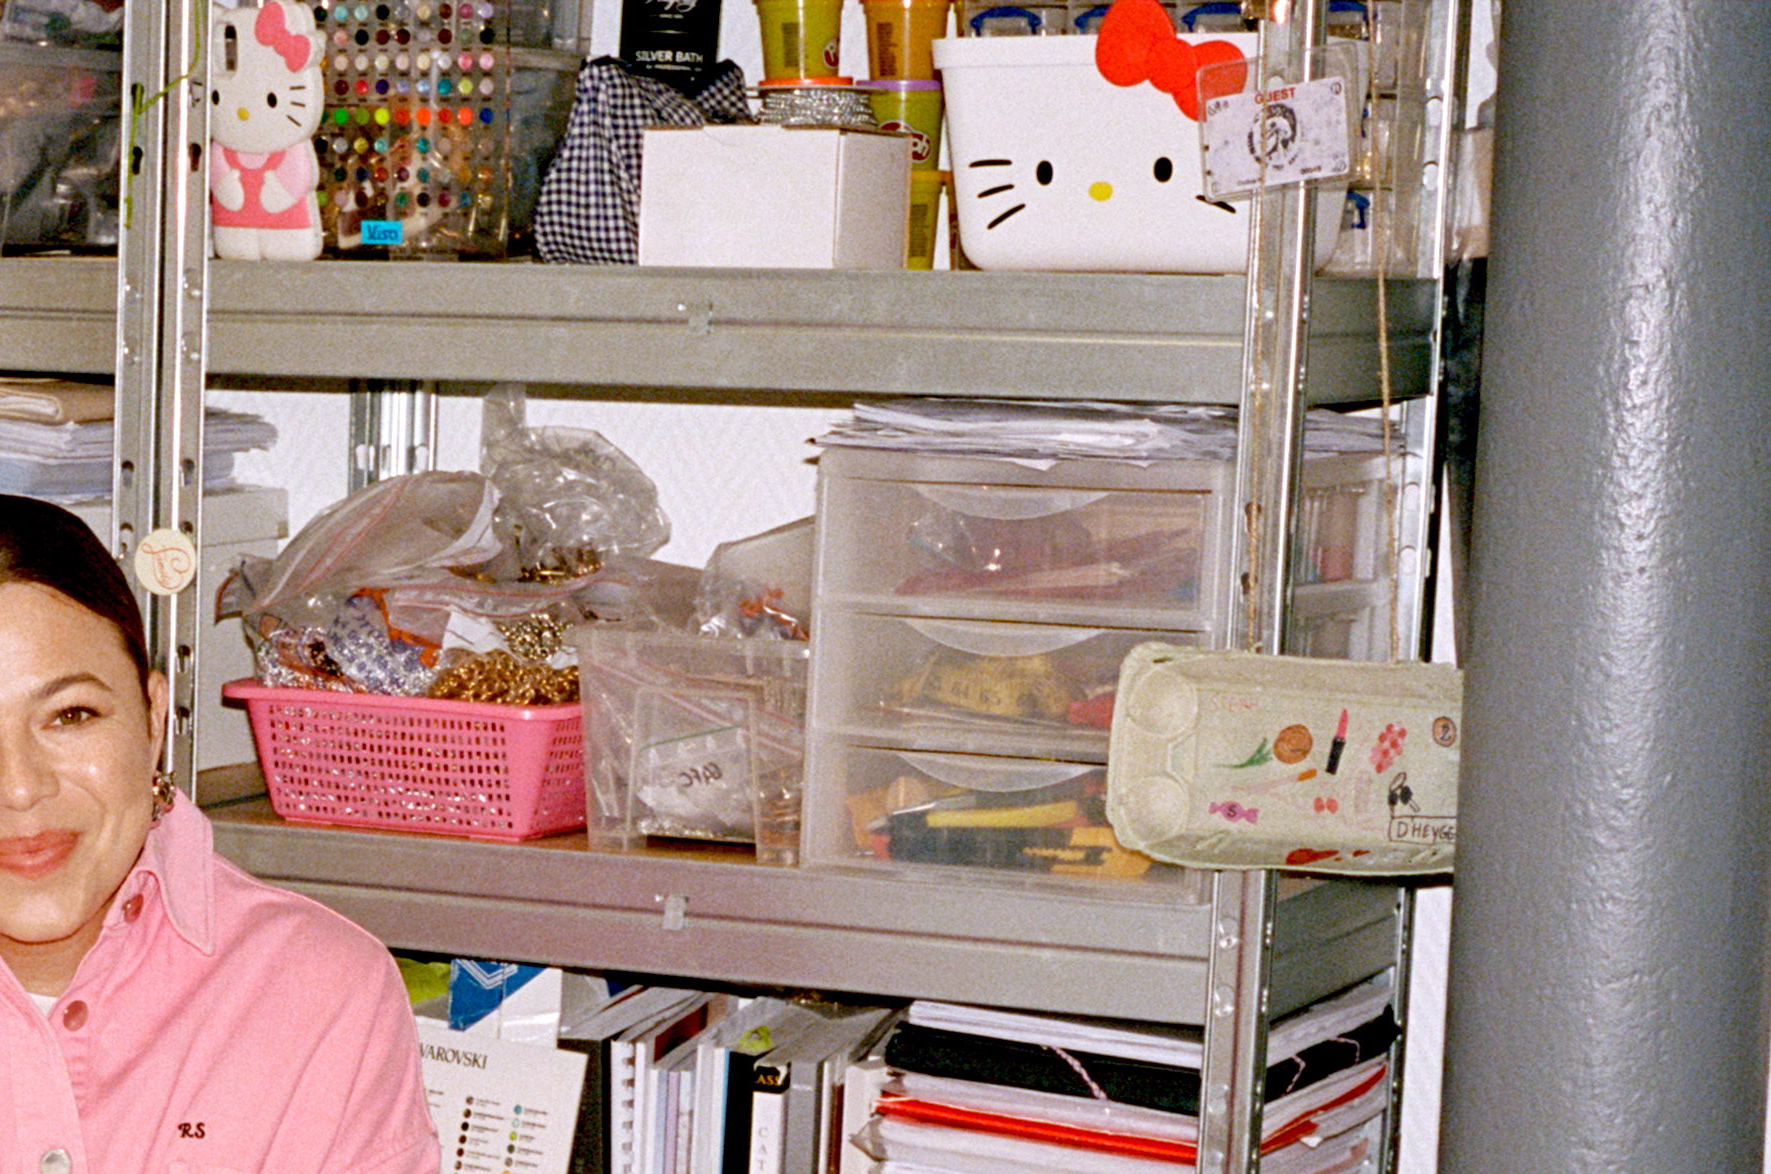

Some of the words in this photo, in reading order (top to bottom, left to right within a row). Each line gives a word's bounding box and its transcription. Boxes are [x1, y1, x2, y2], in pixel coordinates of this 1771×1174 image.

[635, 50, 673, 62] SILVER
[674, 51, 704, 63] BATH
[178, 1122, 206, 1139] RS
